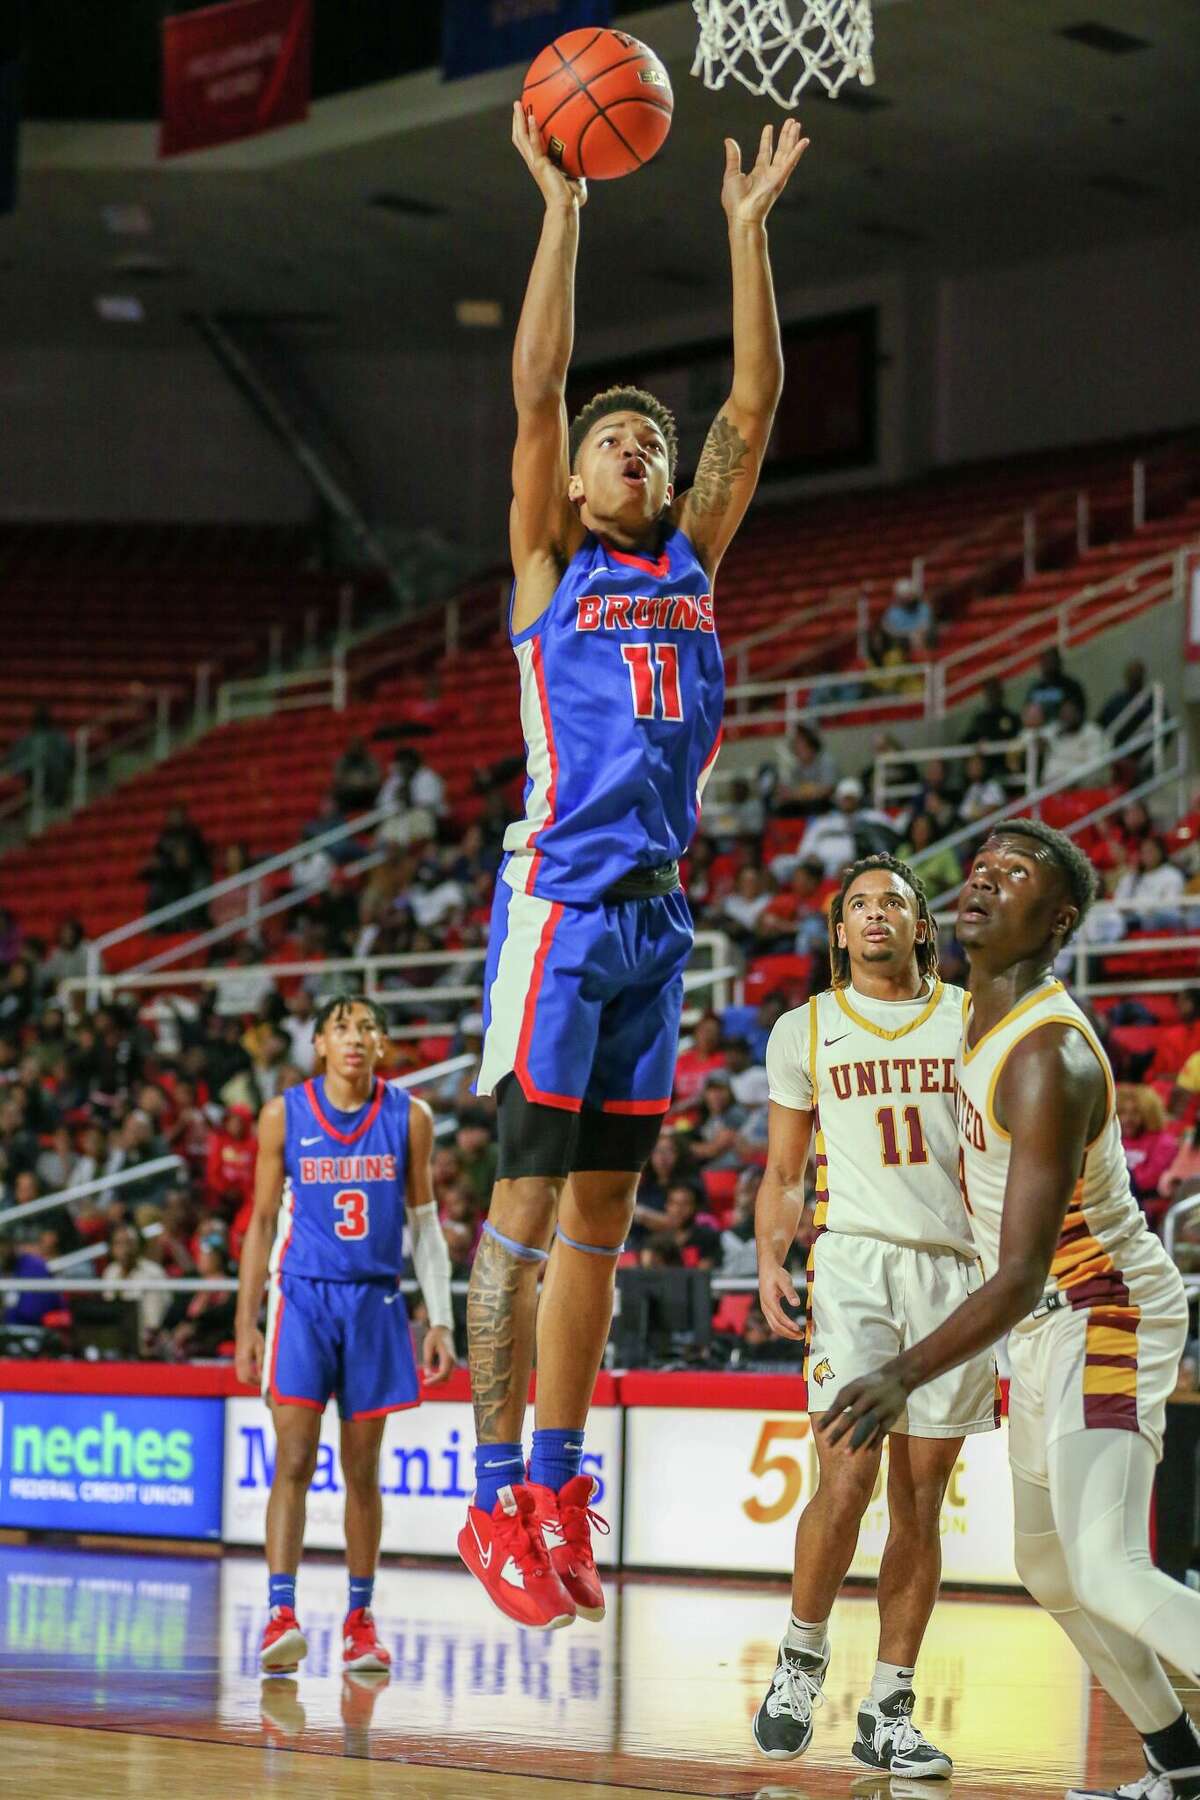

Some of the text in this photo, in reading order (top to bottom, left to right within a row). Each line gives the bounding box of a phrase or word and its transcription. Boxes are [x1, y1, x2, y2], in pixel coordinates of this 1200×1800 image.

[575, 594, 716, 634] BRUINS
[620, 643, 685, 722] 11
[875, 1104, 929, 1168] 11
[299, 1154, 397, 1184] BRUINS
[334, 1189, 369, 1241] 3
[12, 1411, 193, 1481] neches
